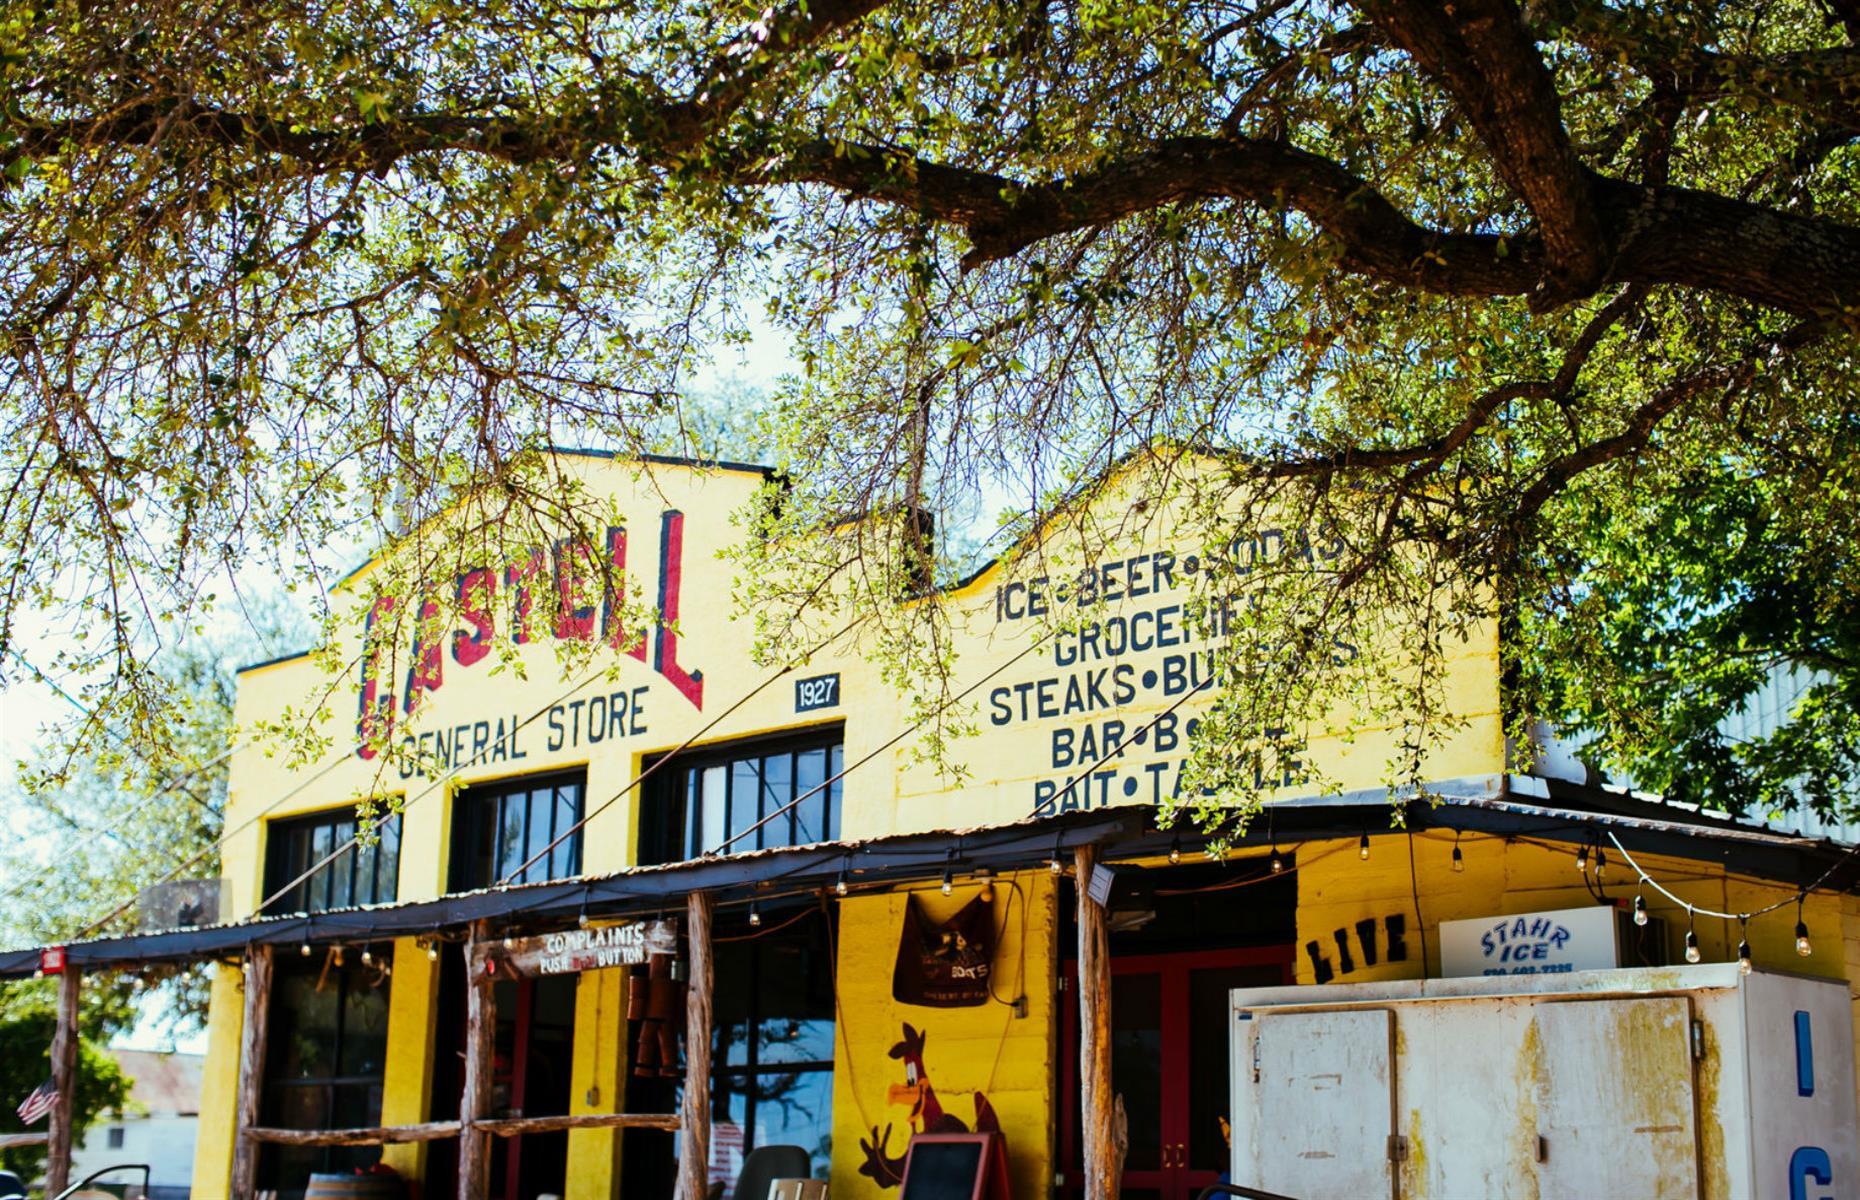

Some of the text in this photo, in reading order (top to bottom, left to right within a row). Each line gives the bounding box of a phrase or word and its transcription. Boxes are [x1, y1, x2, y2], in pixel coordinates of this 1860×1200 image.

[997, 576, 1050, 624] ICE
[1077, 551, 1176, 608] BEER
[800, 678, 836, 707] 1927
[990, 663, 1136, 727] STEAKS
[399, 686, 650, 780] GENERAL STORE
[1035, 769, 1117, 819] BAIT
[540, 957, 568, 974] PUSH
[597, 945, 645, 967] BUTTON
[546, 921, 646, 954] COMPLAINTS
[1306, 912, 1407, 985] LIVE
[1481, 917, 1571, 958] STAHR
[1500, 943, 1549, 962] ICE
